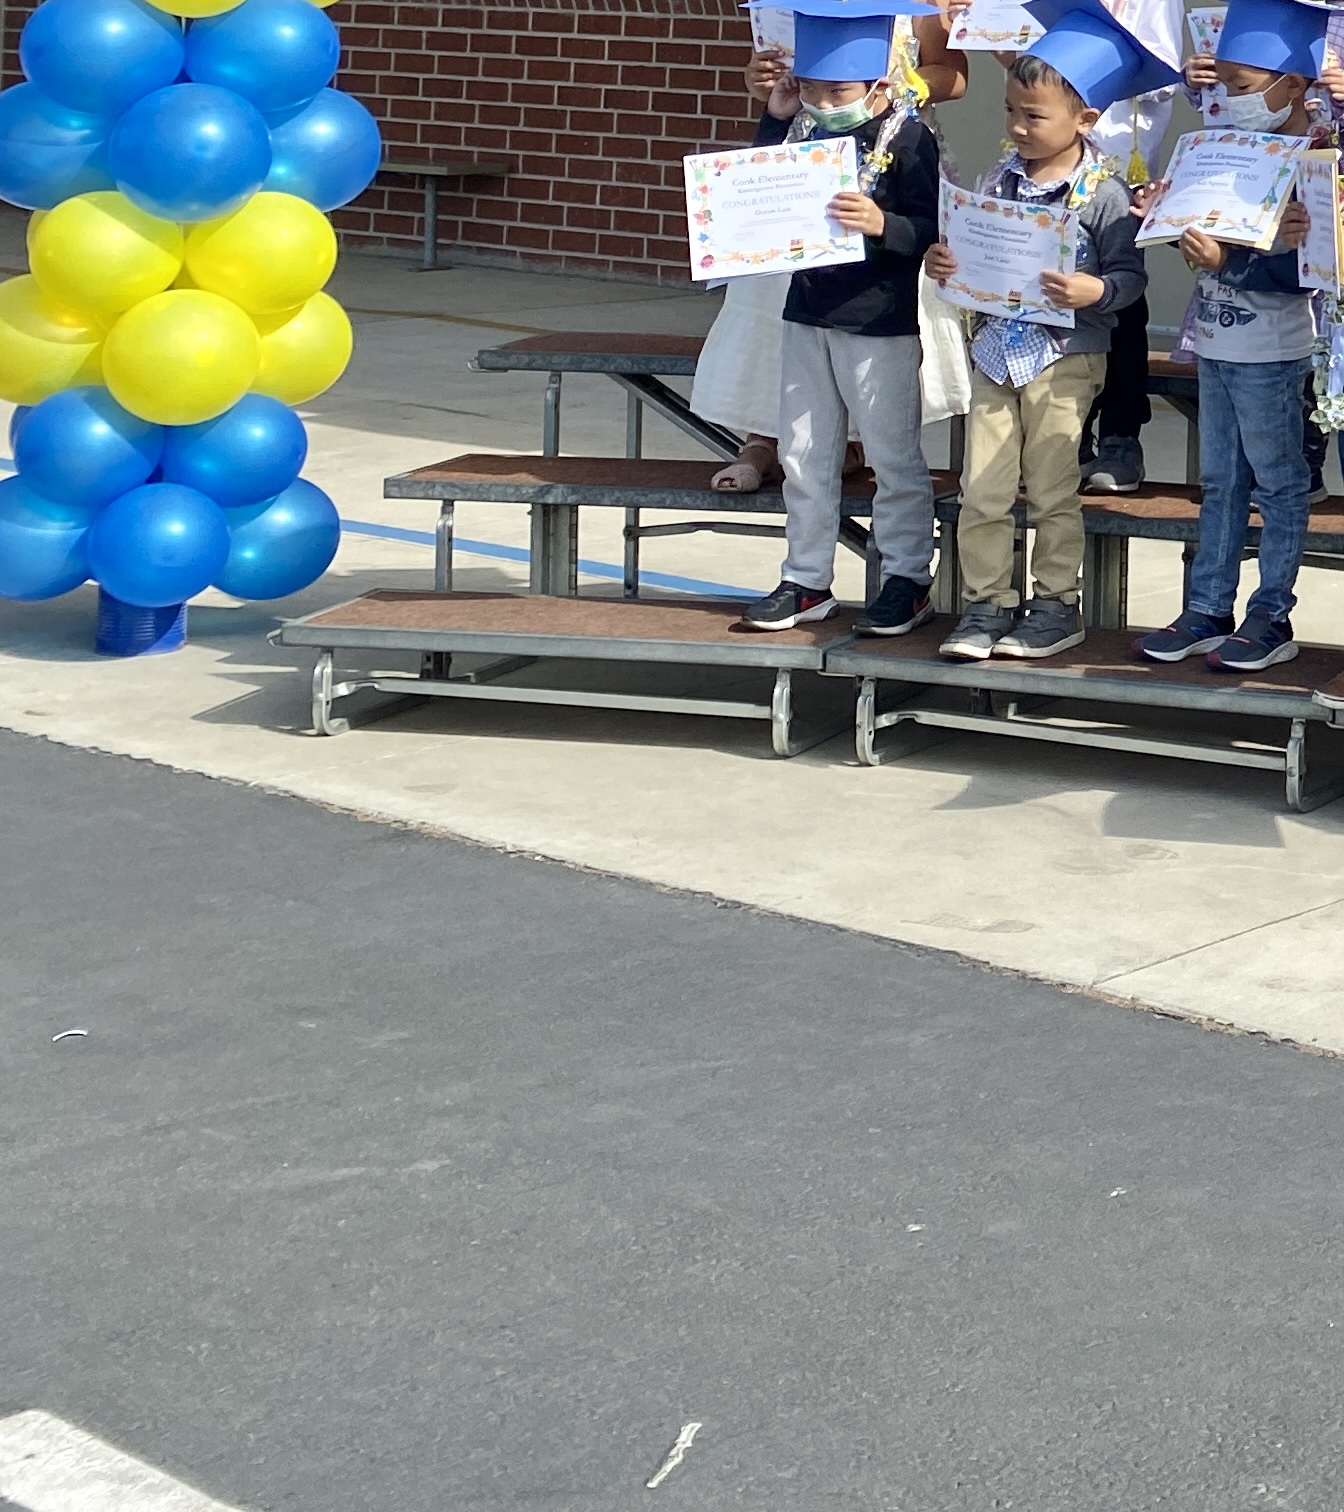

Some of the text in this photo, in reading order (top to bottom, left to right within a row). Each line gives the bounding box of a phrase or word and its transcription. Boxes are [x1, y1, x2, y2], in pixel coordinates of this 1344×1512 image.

[1214, 153, 1258, 164] Elementary
[732, 171, 809, 186] Cook Elementary
[965, 217, 1032, 239] Cook Elementary
